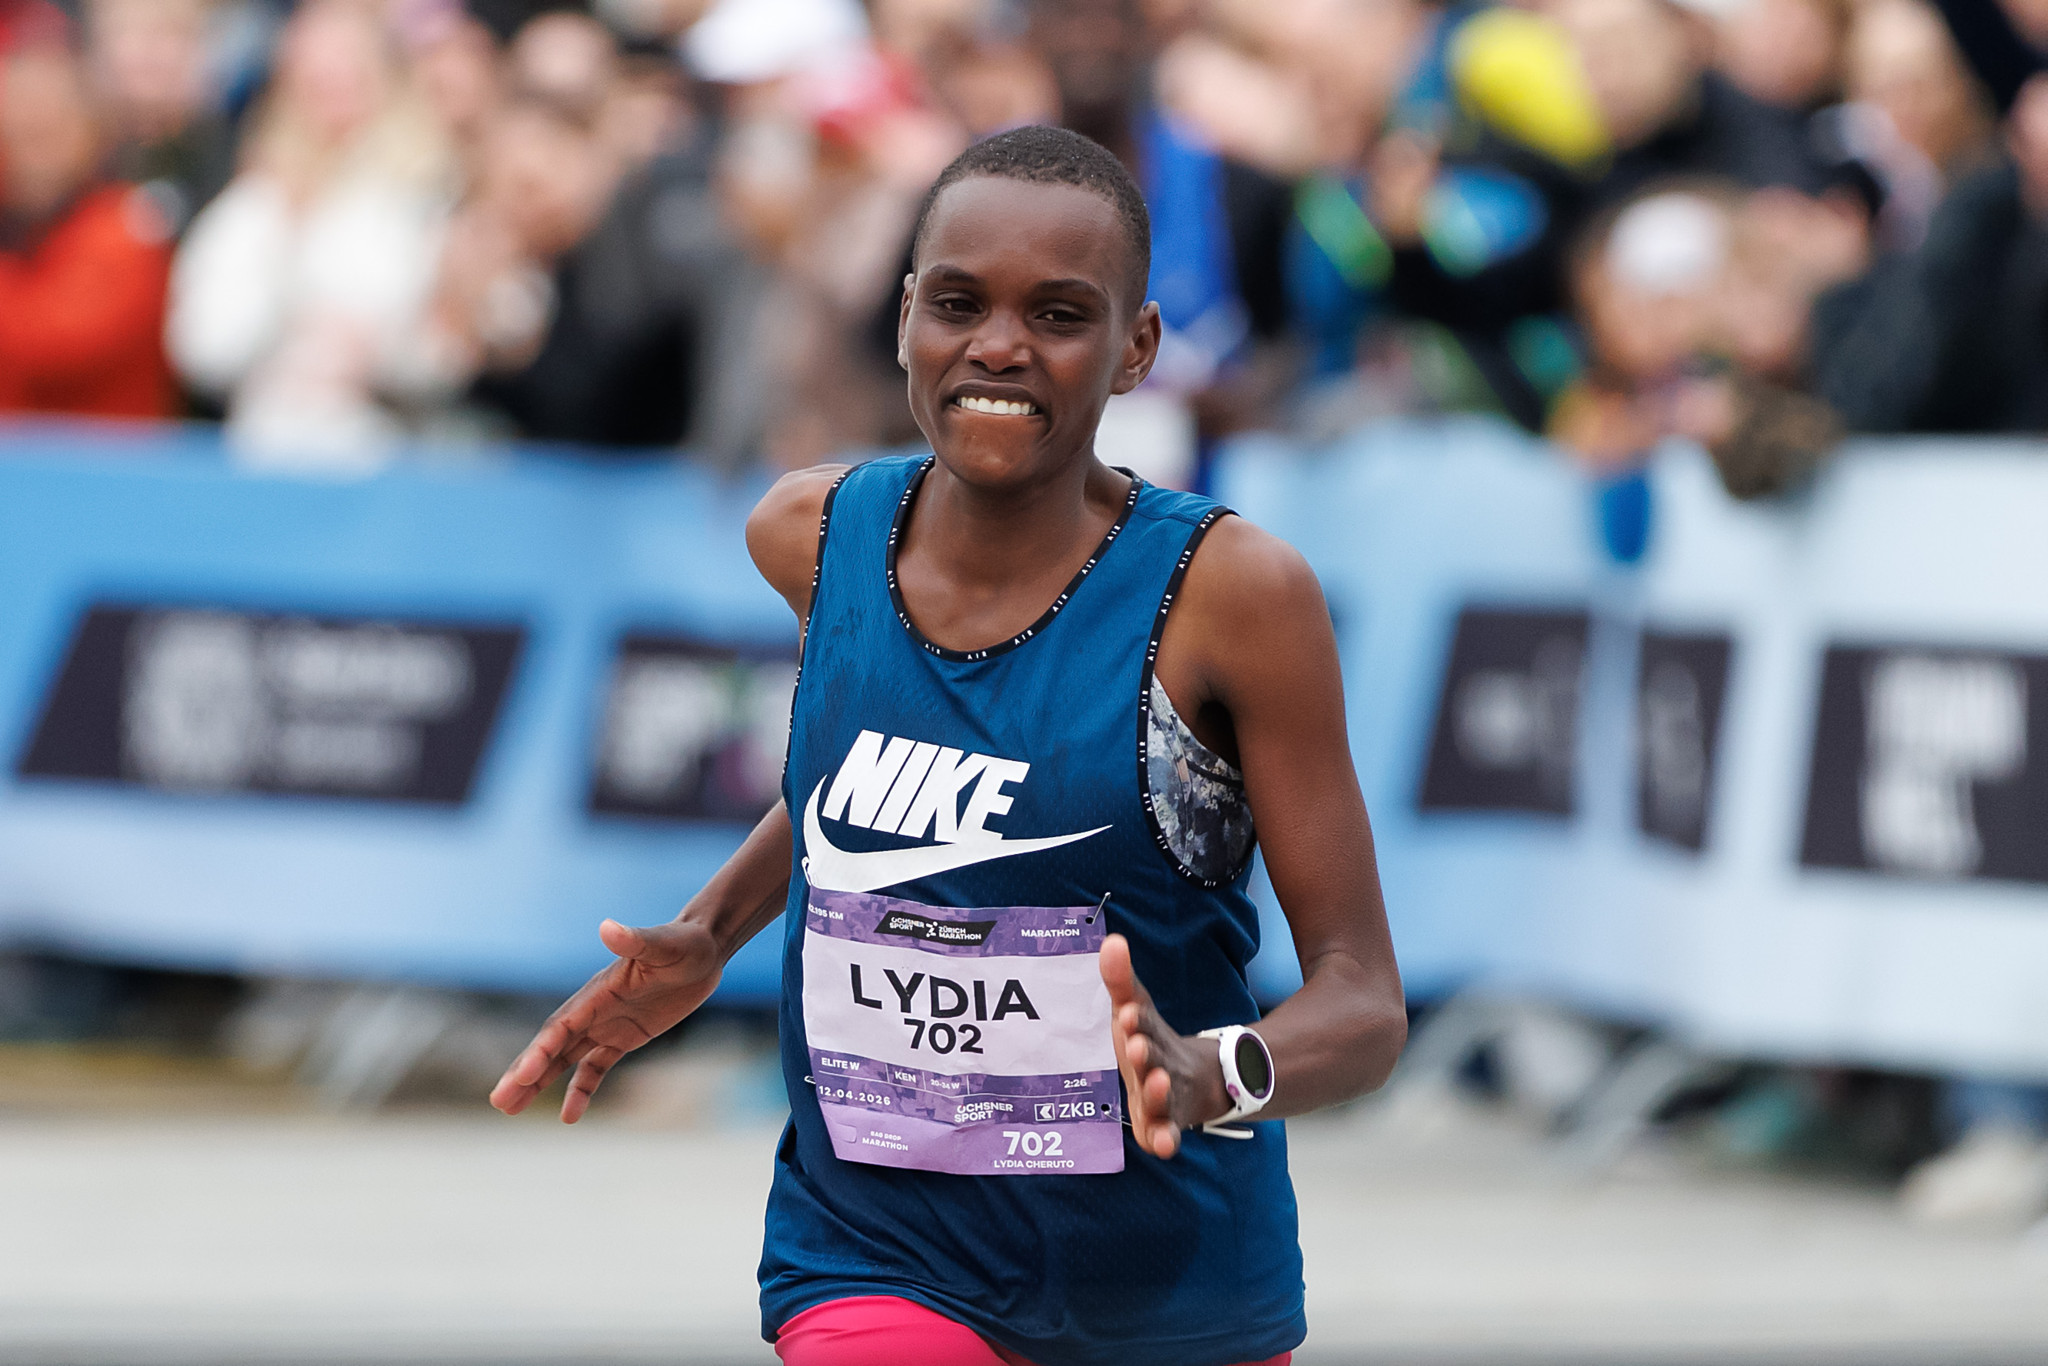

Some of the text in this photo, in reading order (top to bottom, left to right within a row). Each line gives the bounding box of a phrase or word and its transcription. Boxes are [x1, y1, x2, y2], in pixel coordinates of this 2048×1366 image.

[821, 729, 1031, 843] NIKE
[829, 910, 844, 920] KM
[889, 922, 914, 931] SPORT
[938, 925, 966, 934] ZÜRICH
[938, 932, 982, 941] MARATHON
[1021, 928, 1080, 938] MARATHON
[850, 963, 1041, 1021] LYDIA
[904, 1018, 984, 1055] 702
[821, 1057, 860, 1071] ELITE W
[894, 1071, 917, 1083] KEN
[951, 1082, 960, 1090] W
[1063, 1079, 1088, 1089] 2:26
[818, 1085, 891, 1106] 12.04.2026
[1058, 1101, 1096, 1118] ZKB
[954, 1110, 993, 1123] SPORT
[862, 1137, 909, 1151] MARATHON
[1002, 1131, 1064, 1157] 702
[993, 1160, 1075, 1169] LYDIA CHERUTO
